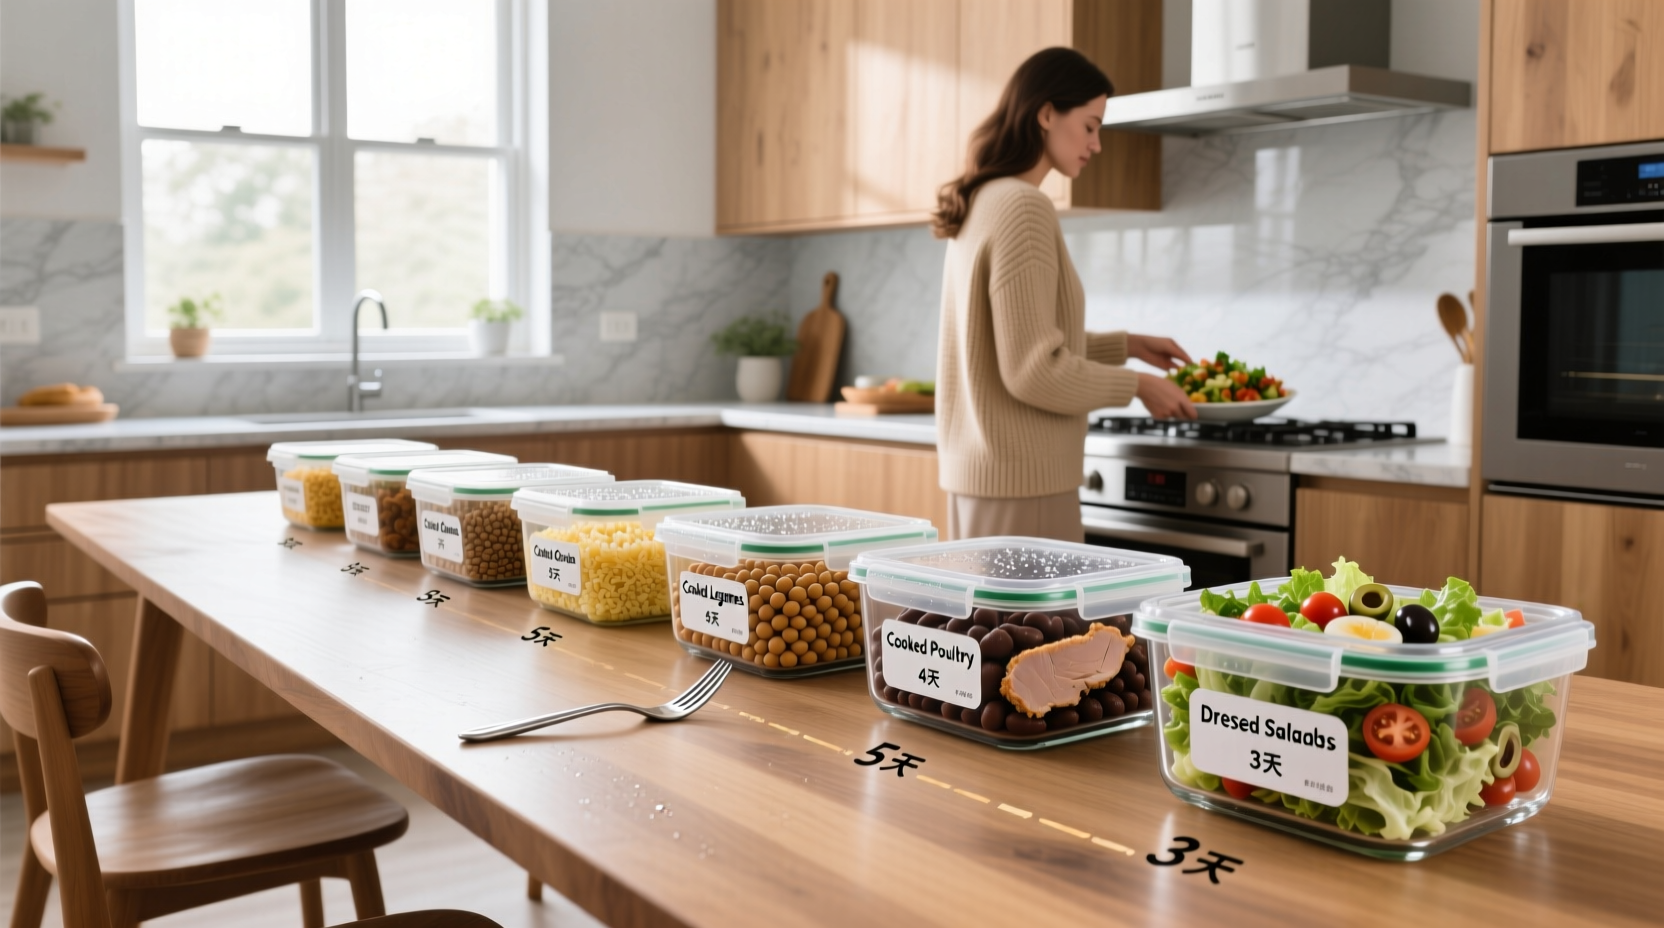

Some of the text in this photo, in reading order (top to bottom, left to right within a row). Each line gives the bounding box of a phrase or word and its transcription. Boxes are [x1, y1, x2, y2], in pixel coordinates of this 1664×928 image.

[521, 626, 563, 647] 5天
[886, 631, 975, 670] Cooked Poultry
[918, 667, 940, 689] 4天
[1201, 704, 1260, 735] Dresed
[853, 741, 926, 778] 5天
[1249, 749, 1283, 777] 3天
[1146, 835, 1244, 885] 3天
